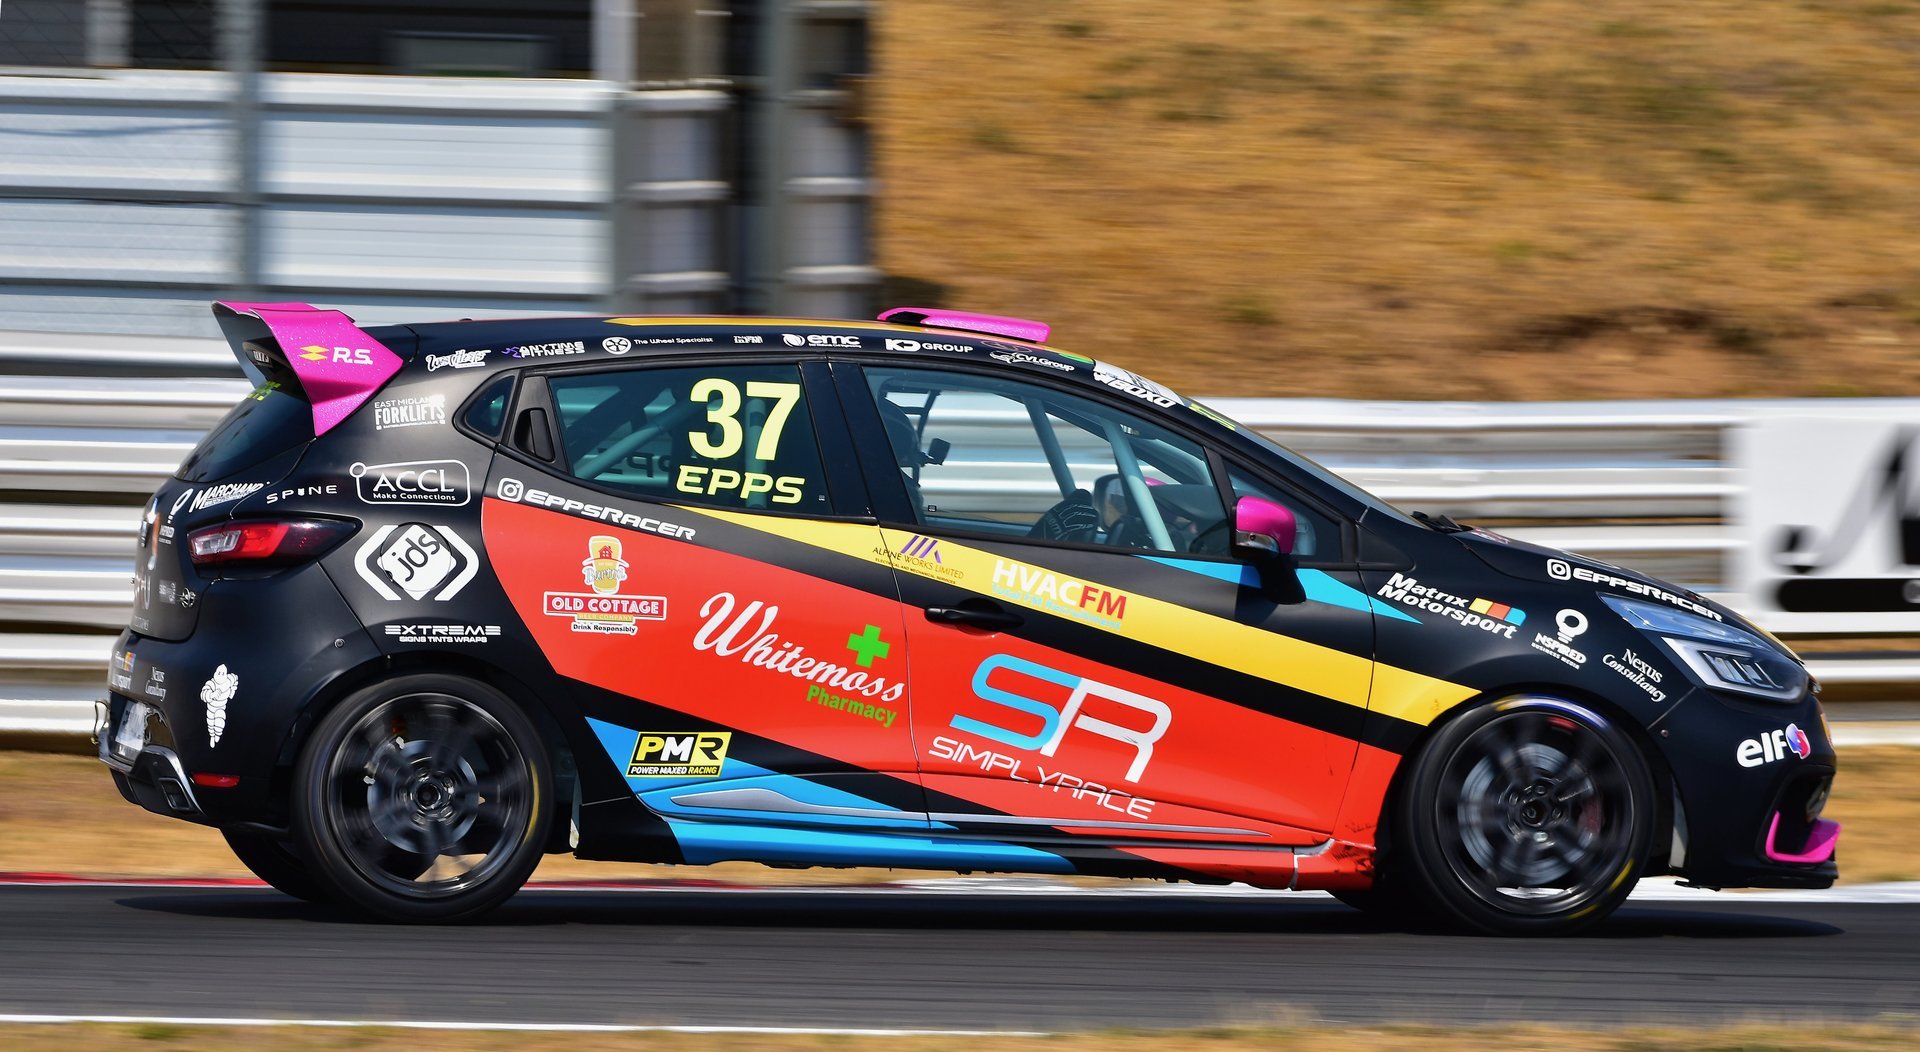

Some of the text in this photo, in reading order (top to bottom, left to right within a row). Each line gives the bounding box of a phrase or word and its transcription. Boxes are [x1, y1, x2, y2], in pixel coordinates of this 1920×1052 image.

[519, 341, 584, 352] ANYTIME
[521, 349, 586, 358] FITNESS
[807, 334, 860, 345] emc
[922, 343, 973, 353] GROUP
[374, 400, 397, 409] EAST
[374, 405, 446, 426] FORKLIFTS
[689, 378, 801, 461] 37
[373, 469, 455, 492] ACCL
[373, 492, 456, 501] Make Connections
[676, 465, 806, 504] EPPS
[524, 488, 697, 541] EPPSRACER
[391, 534, 441, 582] jds
[872, 546, 965, 579] ALPINE WORKS LIMITED
[551, 597, 660, 614] OLD COTTAGE
[992, 559, 1128, 620] HVACFM
[1386, 571, 1470, 609] Matrix
[1573, 566, 1723, 623] EPPSRACER
[1376, 583, 1519, 640] Motorsport
[385, 625, 501, 636] EXTREME
[453, 636, 488, 644] WRAPS
[594, 625, 636, 634] Responsibly
[692, 592, 905, 702] Whitemoss
[1531, 642, 1581, 670] BUSINESS MEDIA
[1534, 632, 1588, 665] NSPIRED
[1602, 653, 1668, 703] Consultancy
[1622, 648, 1664, 684] Nexus
[806, 684, 898, 729] Pharmacy
[636, 736, 724, 762] PMR
[1737, 729, 1790, 769] elf
[630, 766, 718, 775] POWER MAXED RACING
[928, 735, 1156, 820] SIMPLYRACE
